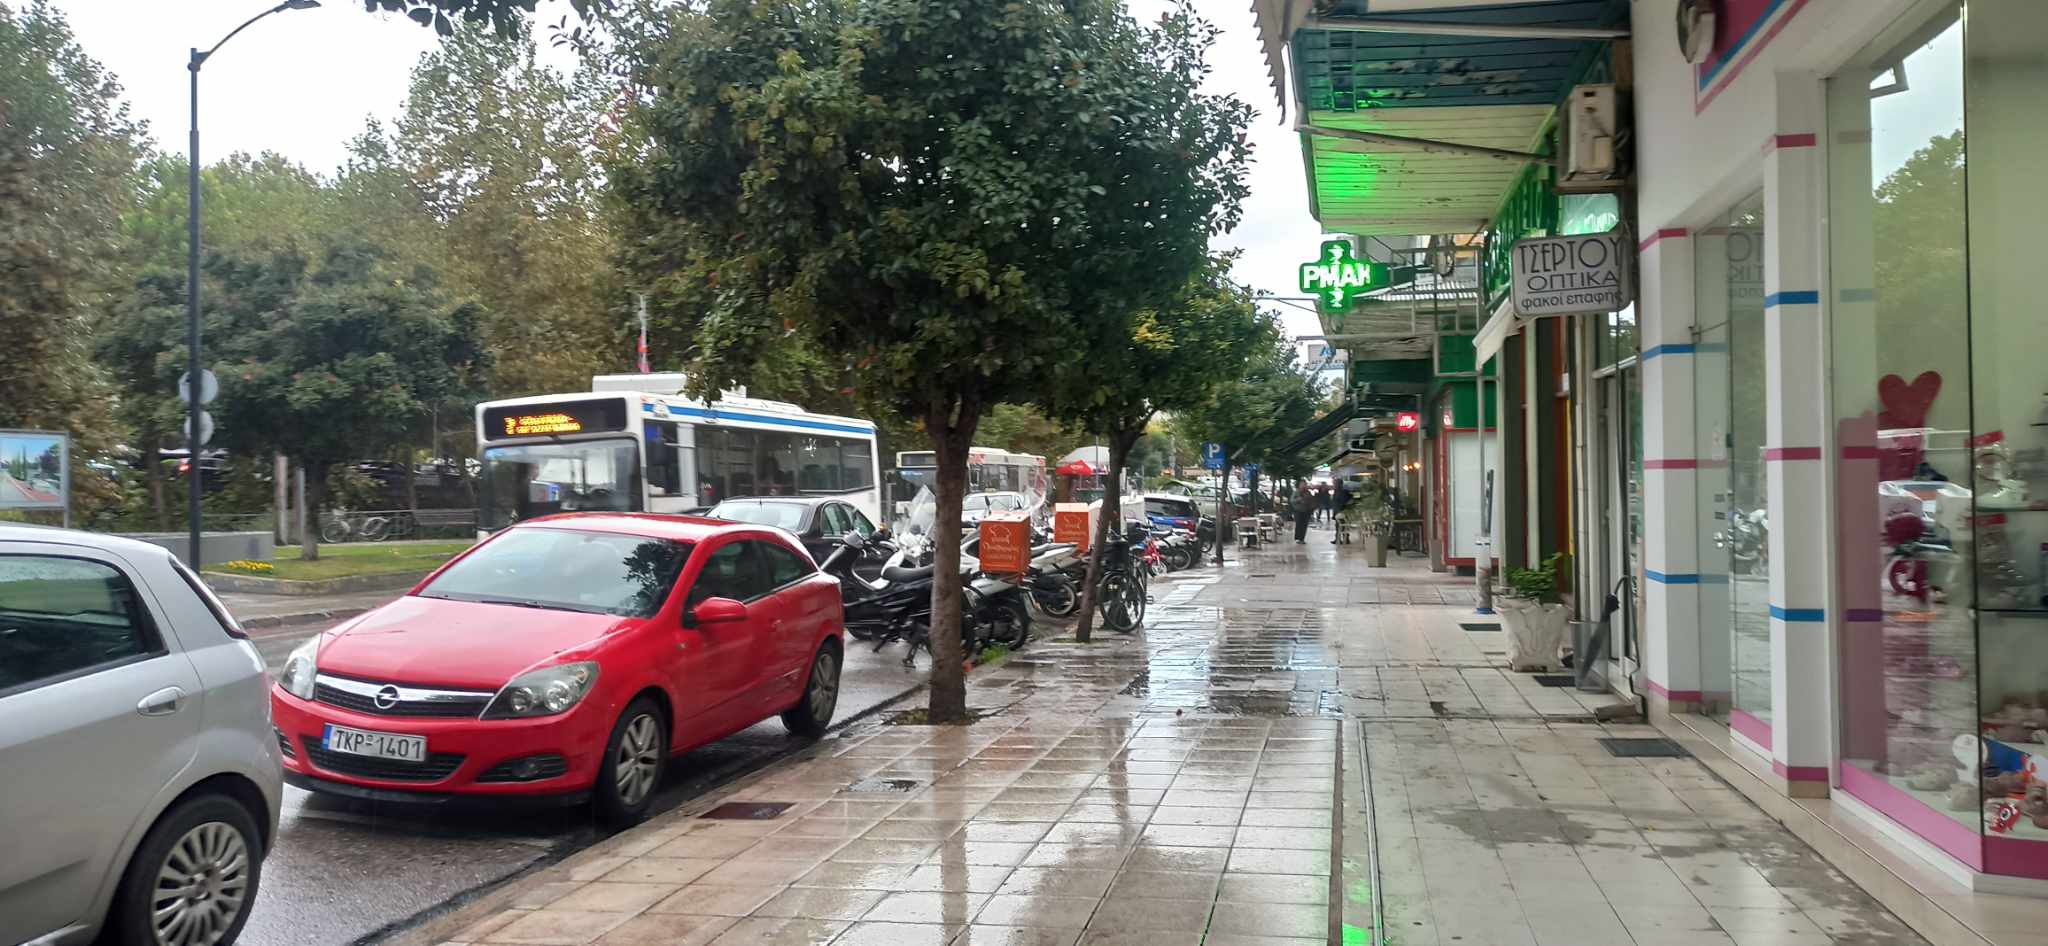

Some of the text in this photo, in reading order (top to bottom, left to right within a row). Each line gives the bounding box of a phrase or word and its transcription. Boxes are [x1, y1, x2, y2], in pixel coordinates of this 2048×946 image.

[1518, 237, 1622, 275] ΤΣΕΡΤΟΥ
[1527, 269, 1618, 291] ΟΠΤΙΚΑ
[1208, 443, 1221, 458] P
